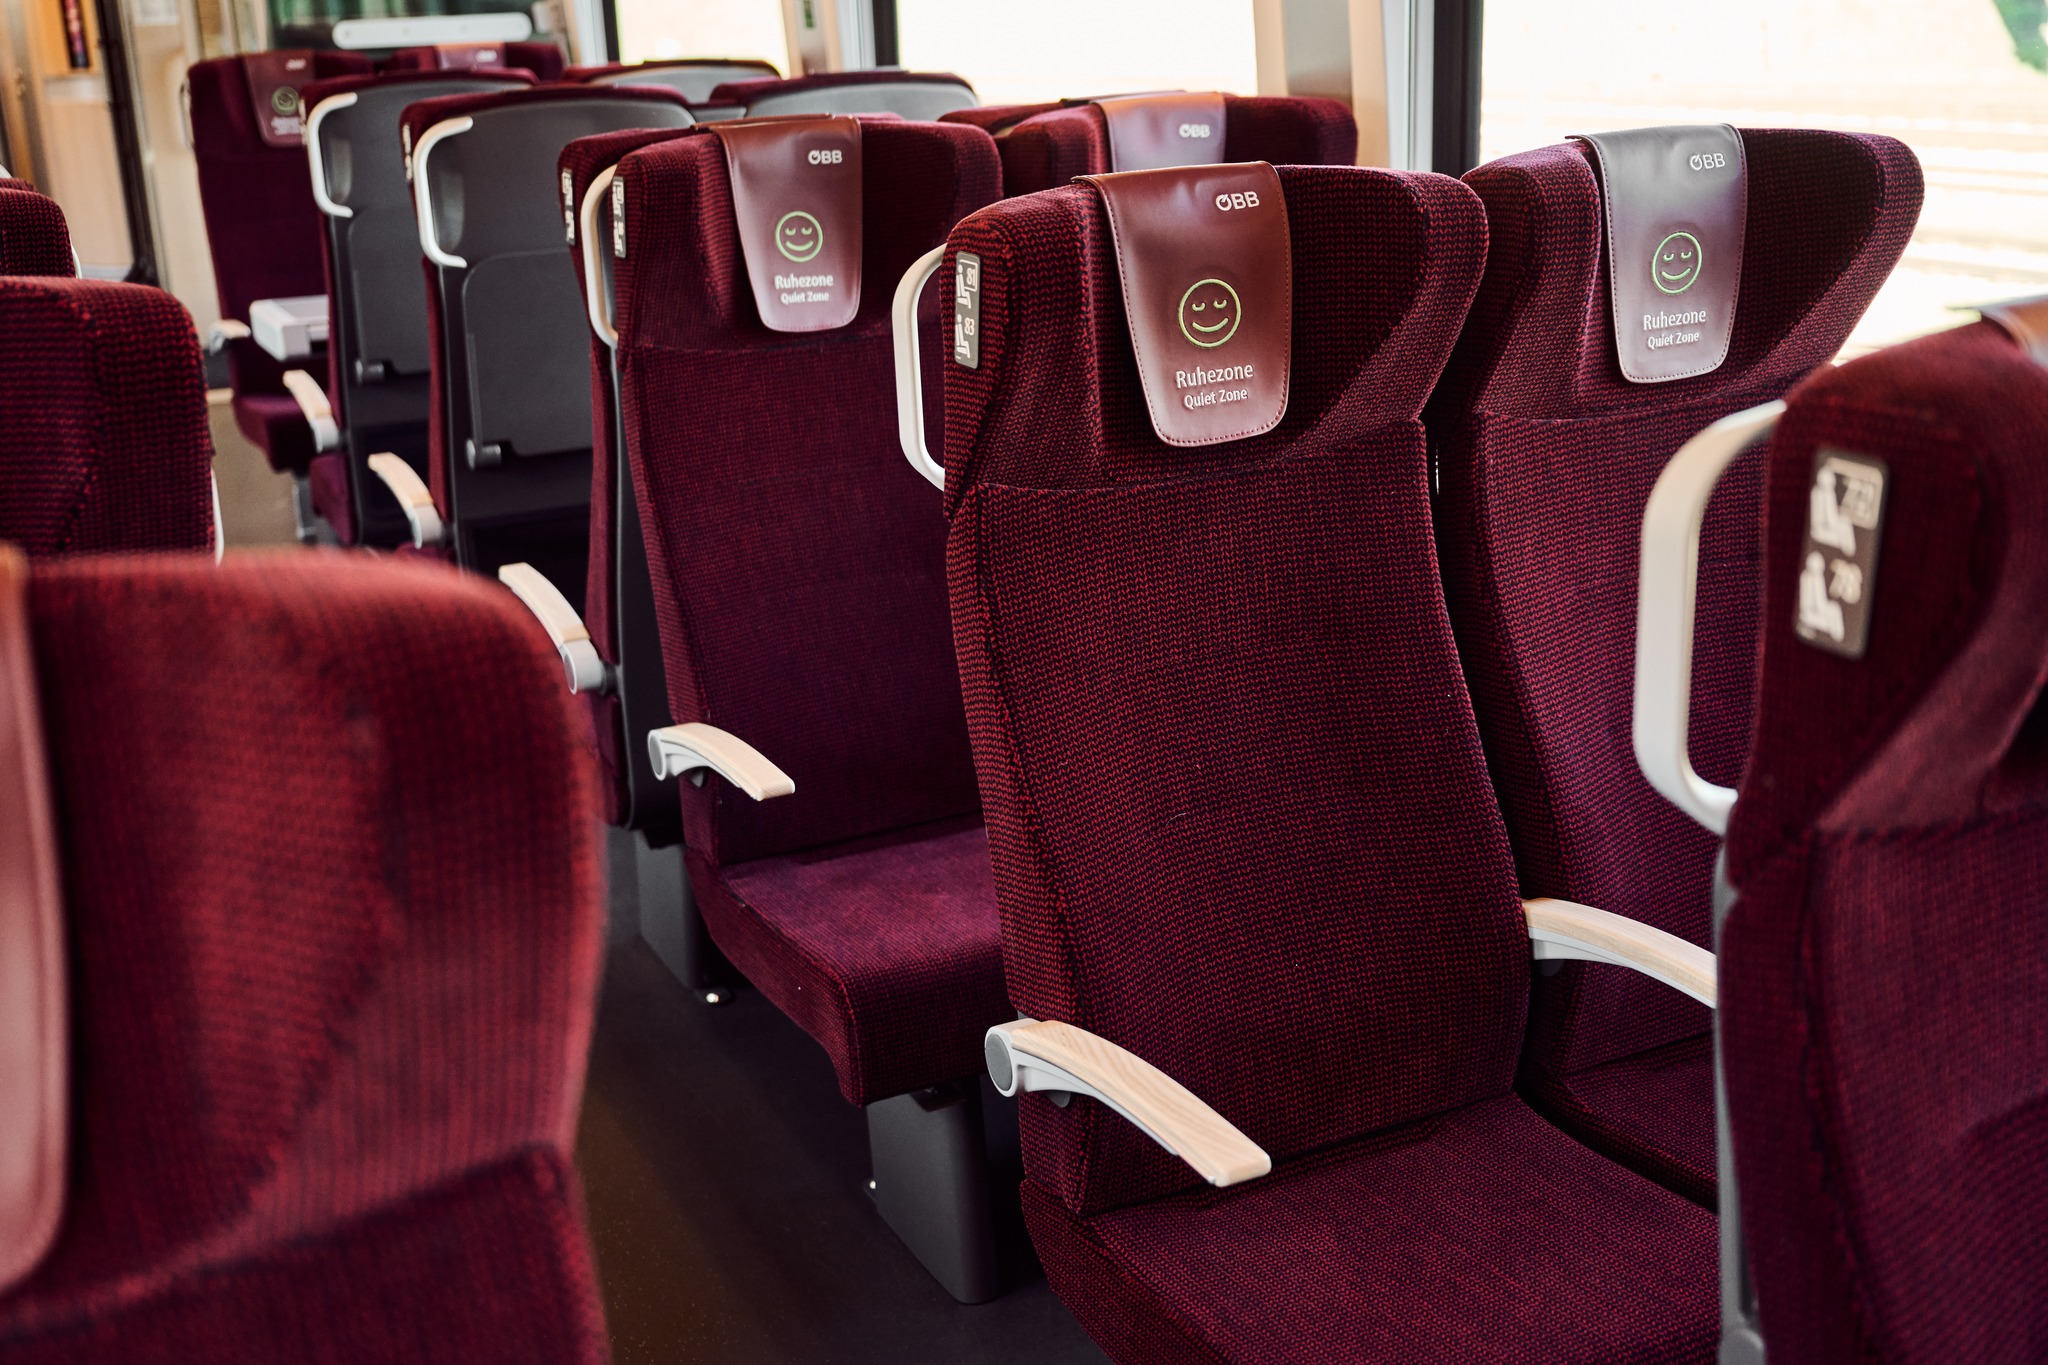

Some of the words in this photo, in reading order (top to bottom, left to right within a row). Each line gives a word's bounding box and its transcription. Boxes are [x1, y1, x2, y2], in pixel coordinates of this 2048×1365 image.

[774, 273, 834, 290] Ruhezone
[780, 291, 806, 305] Quiet
[807, 291, 830, 302] Zone
[1643, 309, 1707, 331] Ruhezone
[1647, 333, 1675, 350] Quiet
[1676, 330, 1700, 345] Zone
[1175, 364, 1254, 389] Ruhezone
[1183, 391, 1217, 410] Quiet
[1219, 388, 1248, 403] Zone
